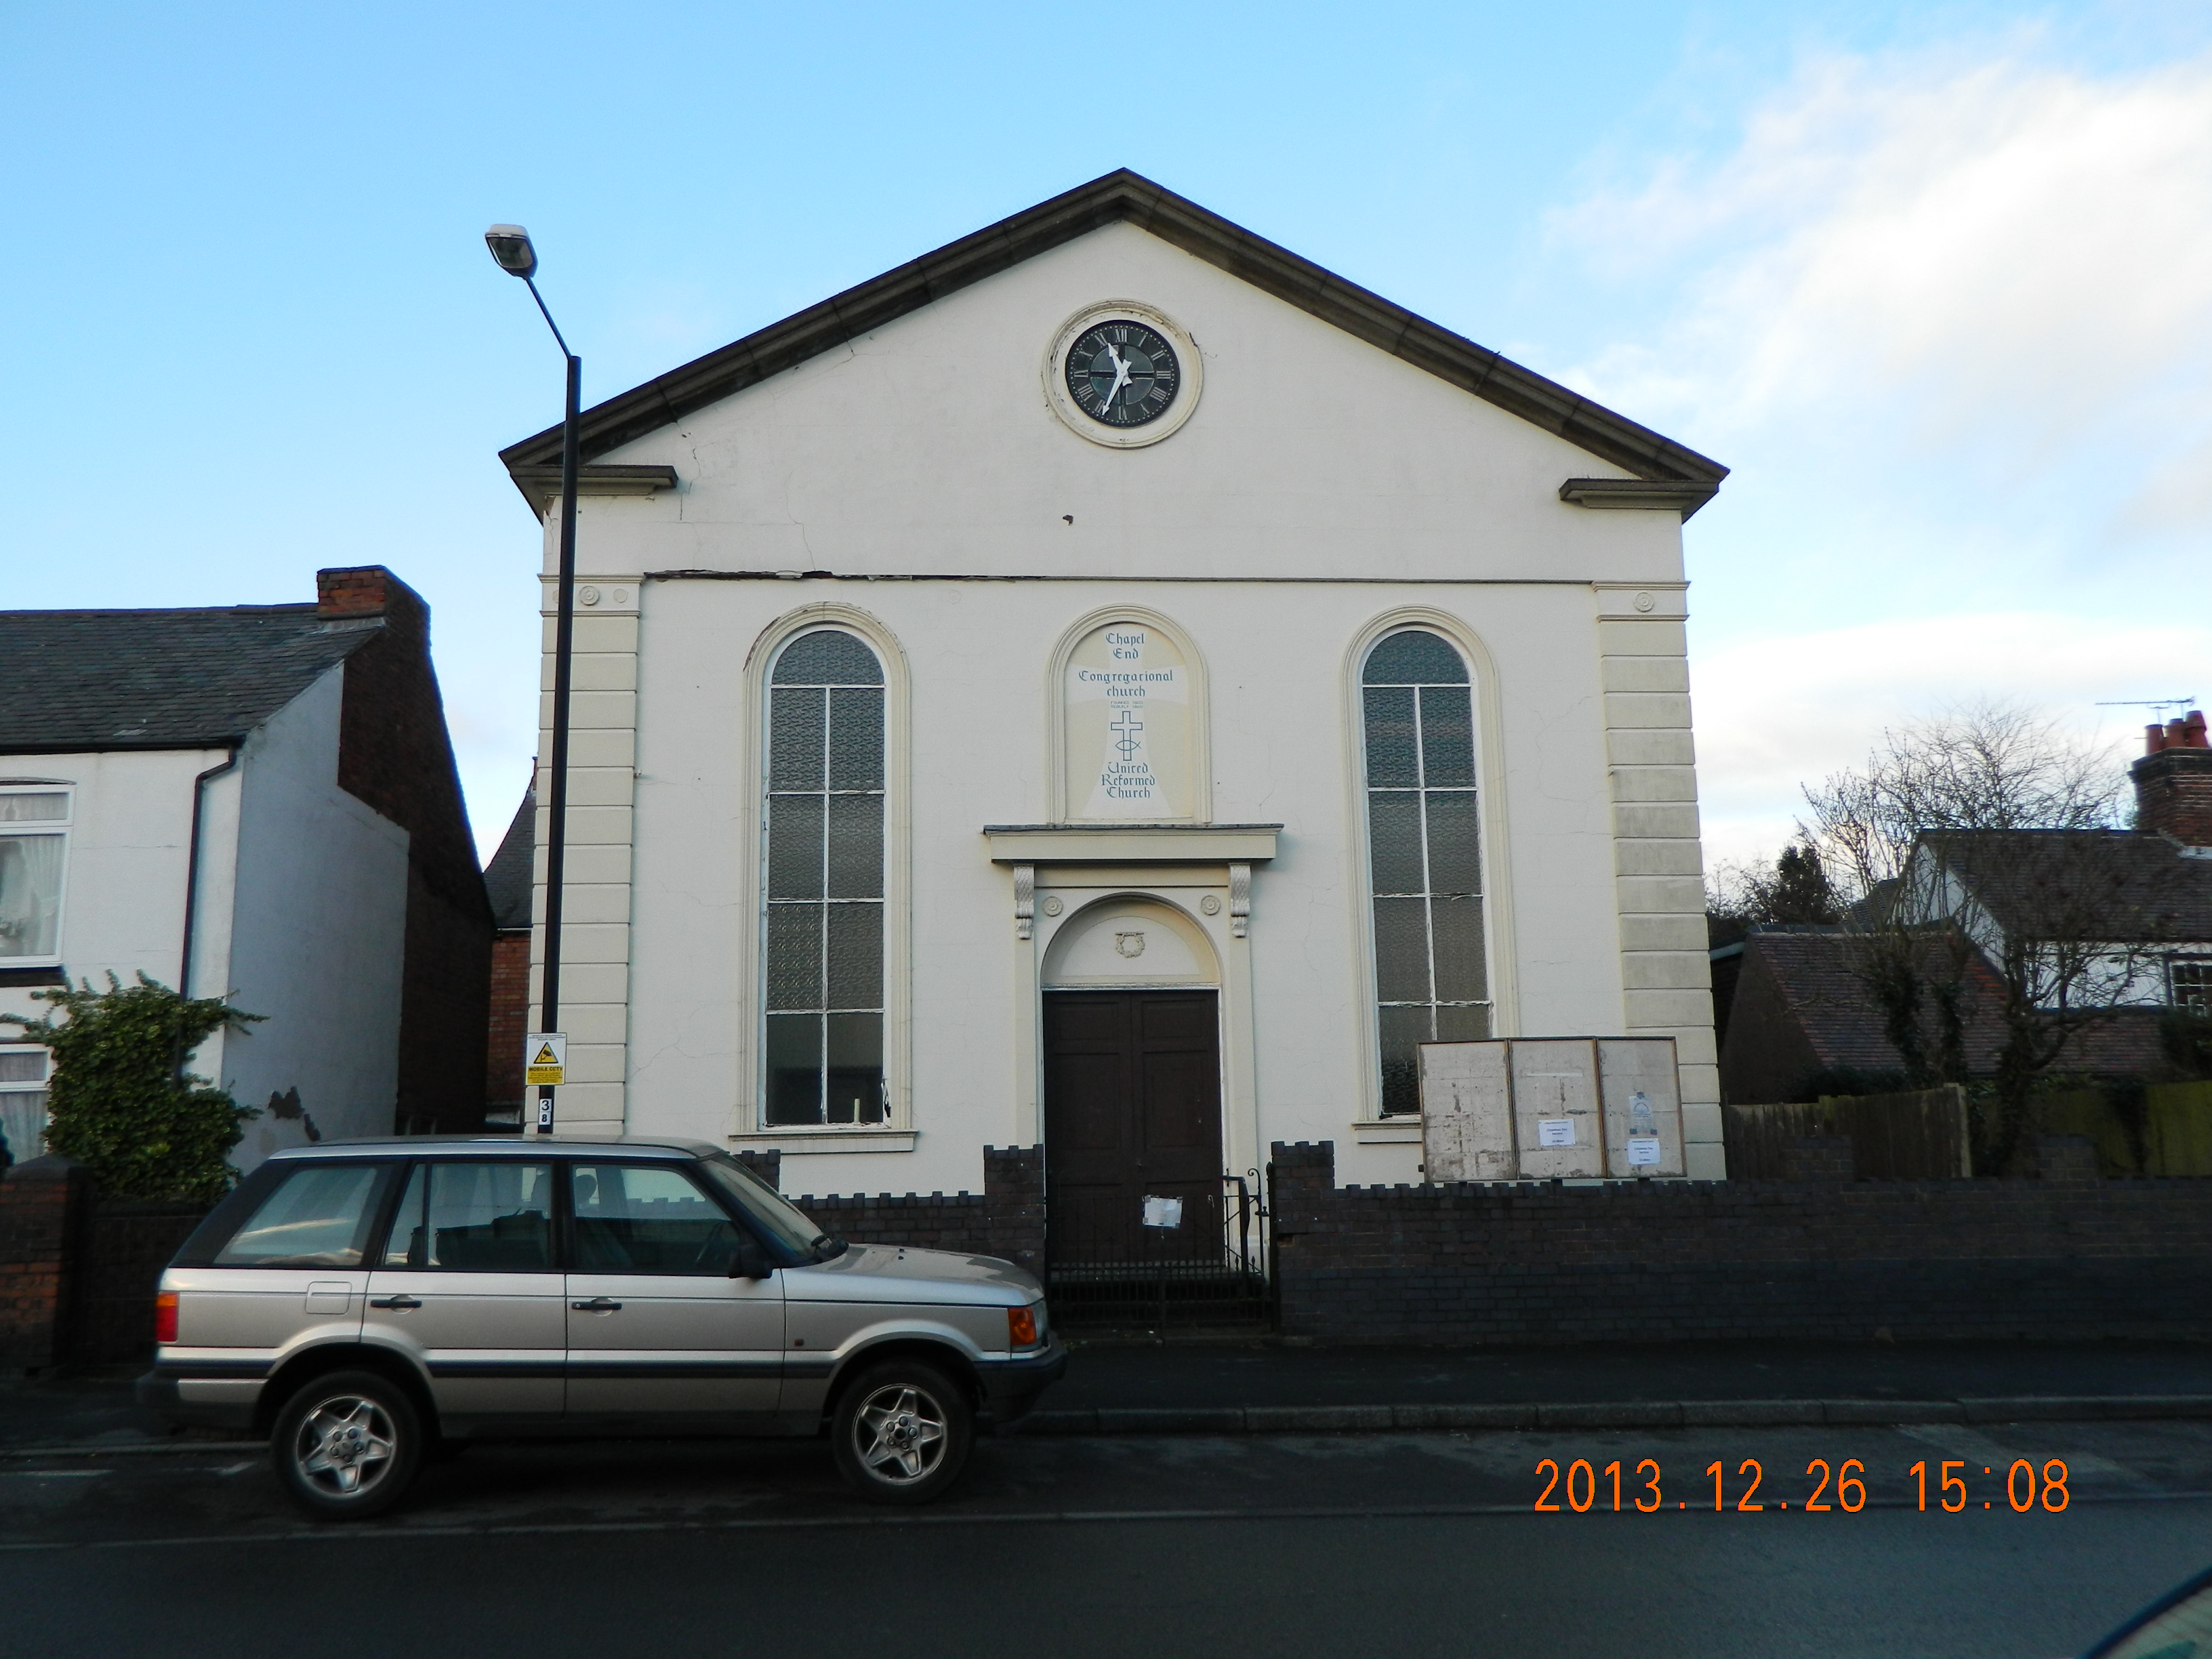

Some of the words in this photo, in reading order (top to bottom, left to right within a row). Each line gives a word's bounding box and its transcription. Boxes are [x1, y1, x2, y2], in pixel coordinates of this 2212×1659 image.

[1115, 329, 1128, 343] XII
[1151, 350, 1166, 361] II
[1156, 371, 1171, 380] III
[1105, 633, 1144, 646] Chapel
[1113, 648, 1139, 659] End
[1079, 670, 1173, 684] Congregational
[1107, 685, 1145, 697] church
[1107, 762, 1149, 774] United
[1101, 774, 1155, 786] Reformed
[1106, 786, 1151, 800] Church
[541, 1100, 550, 1111] 3
[541, 1114, 547, 1122] 8
